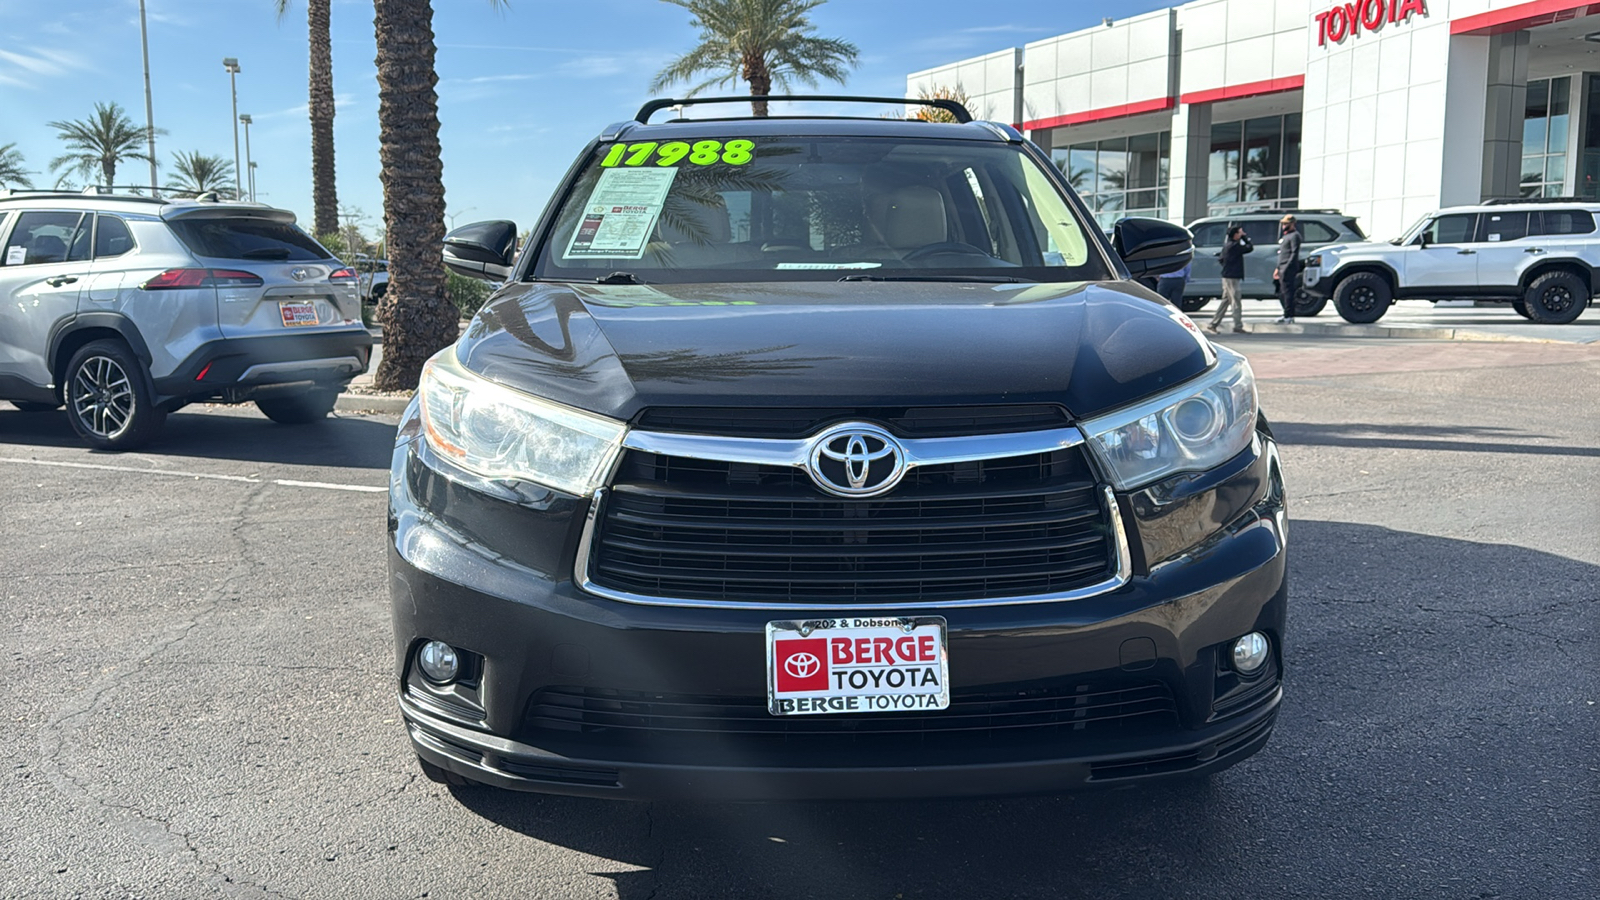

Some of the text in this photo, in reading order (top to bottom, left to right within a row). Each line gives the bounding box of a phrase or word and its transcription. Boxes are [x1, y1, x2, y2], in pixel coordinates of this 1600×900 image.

[601, 139, 755, 166] 17988
[815, 618, 898, 629] 202 & Dobson
[831, 635, 936, 666] BERGE
[832, 668, 939, 689] TOYOTA
[779, 694, 939, 712] BERGE TOYOTA
